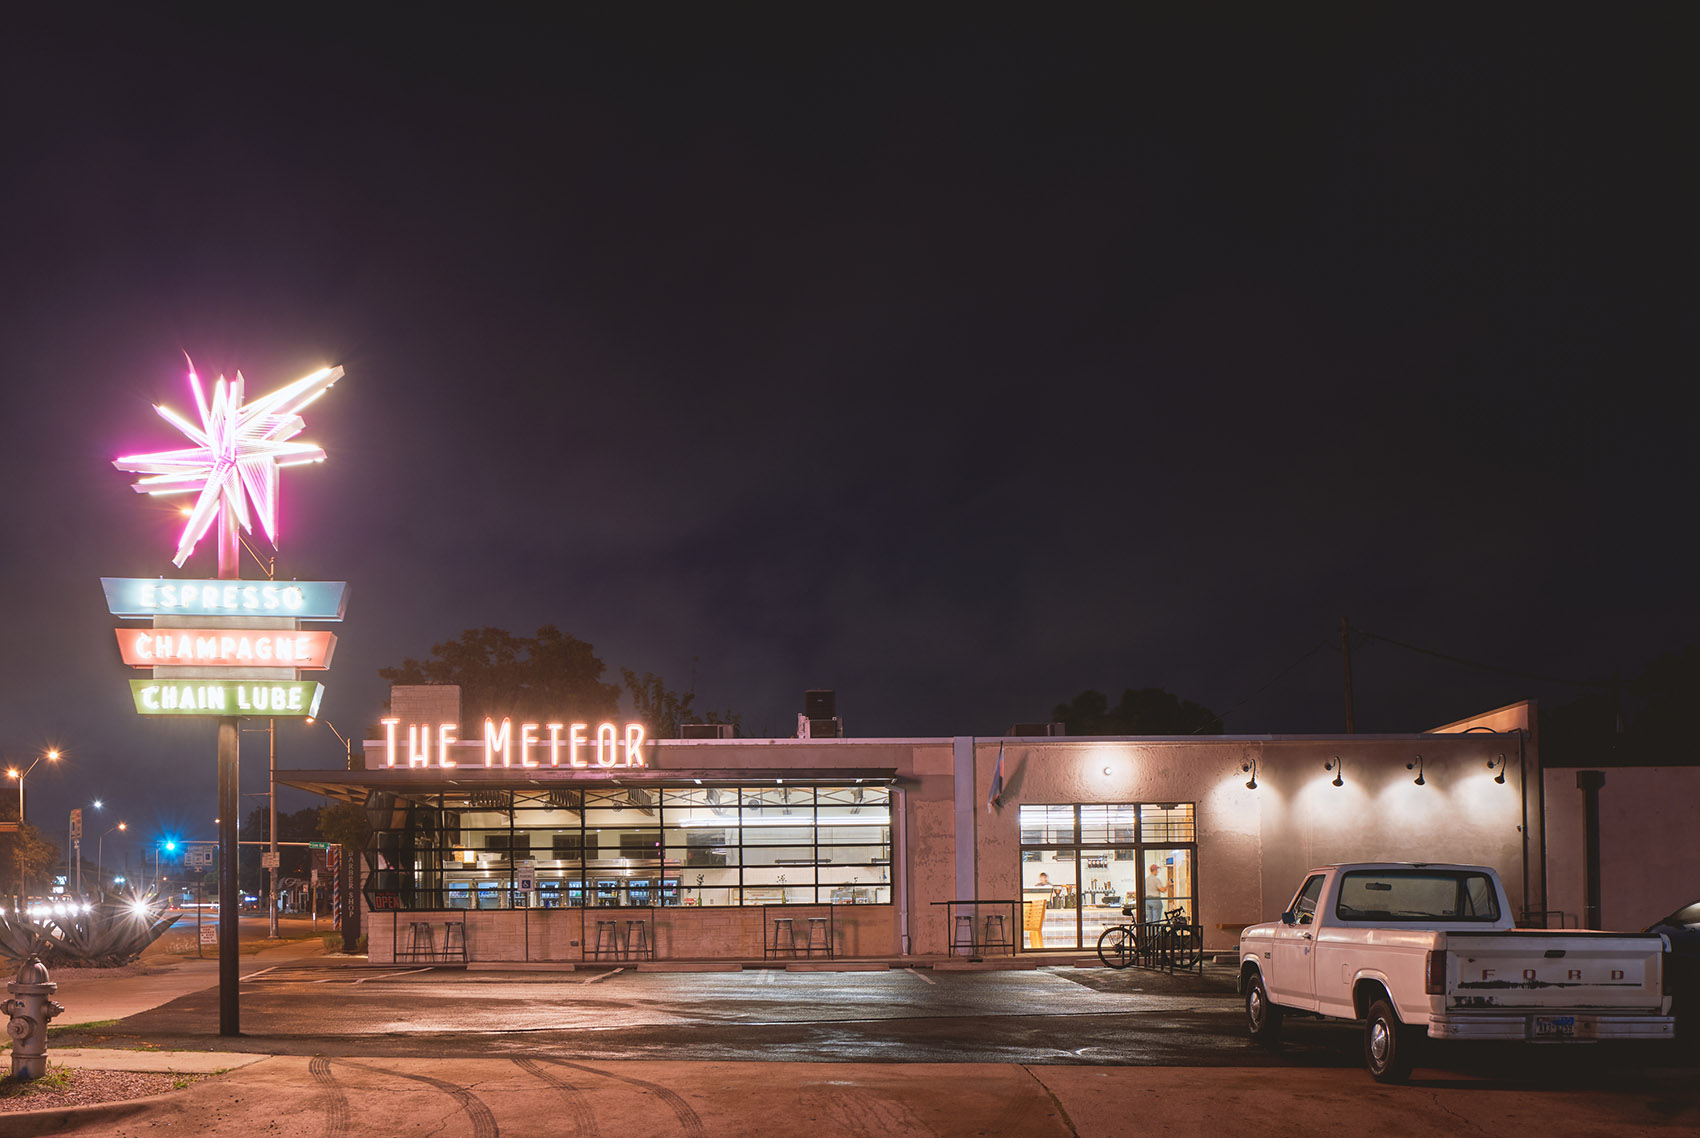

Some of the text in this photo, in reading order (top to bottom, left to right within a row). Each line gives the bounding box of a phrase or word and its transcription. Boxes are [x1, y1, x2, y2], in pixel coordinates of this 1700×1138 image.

[140, 585, 303, 609] ESPRESSO
[135, 633, 312, 660] CHAMPAGNE
[141, 685, 303, 711] CHAIN LUBE
[381, 716, 645, 768] THE METEOR
[375, 896, 400, 909] OPEN
[1482, 968, 1625, 981] FORD
